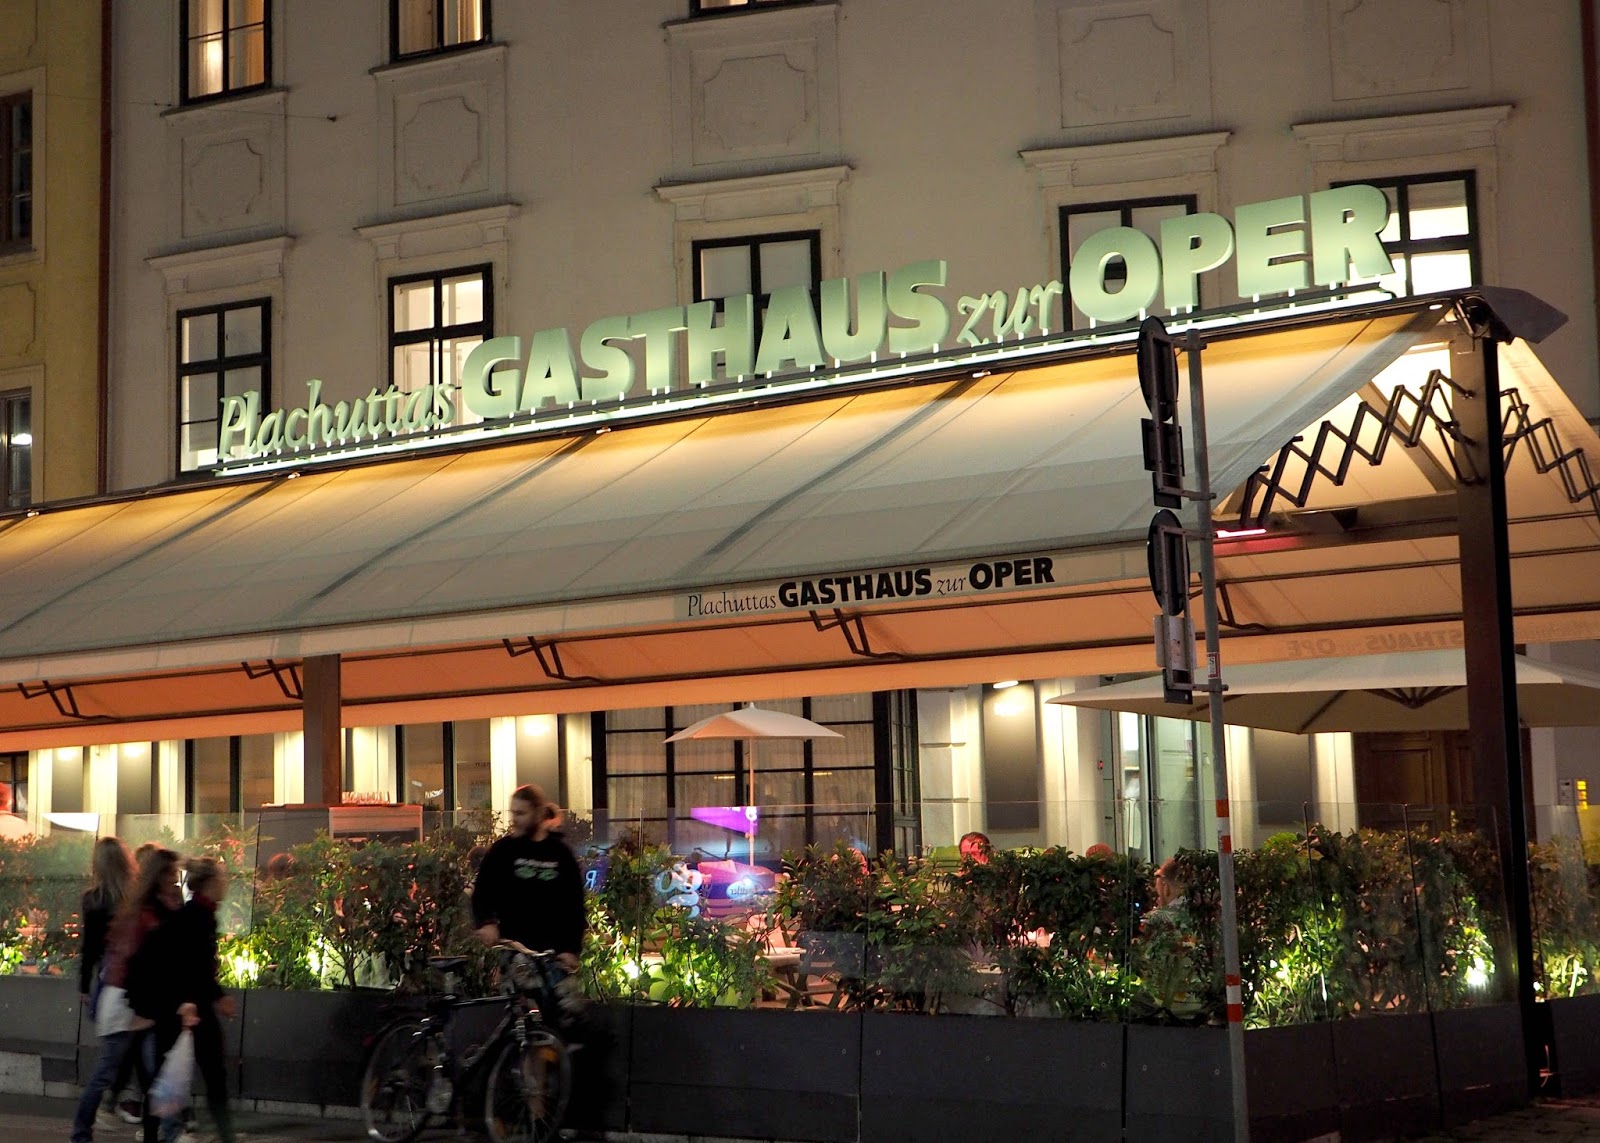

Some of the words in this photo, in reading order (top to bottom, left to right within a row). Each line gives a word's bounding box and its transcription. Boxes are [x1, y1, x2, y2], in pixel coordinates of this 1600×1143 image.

[217, 379, 456, 460] Plachuttas
[462, 259, 950, 419] GASTHAUS
[955, 279, 1064, 346] zur
[1069, 184, 1395, 322] OPER
[687, 591, 777, 617] Plachuttas
[778, 568, 932, 608] GASTHAUS
[937, 574, 966, 595] zur
[968, 556, 1055, 590] OPER
